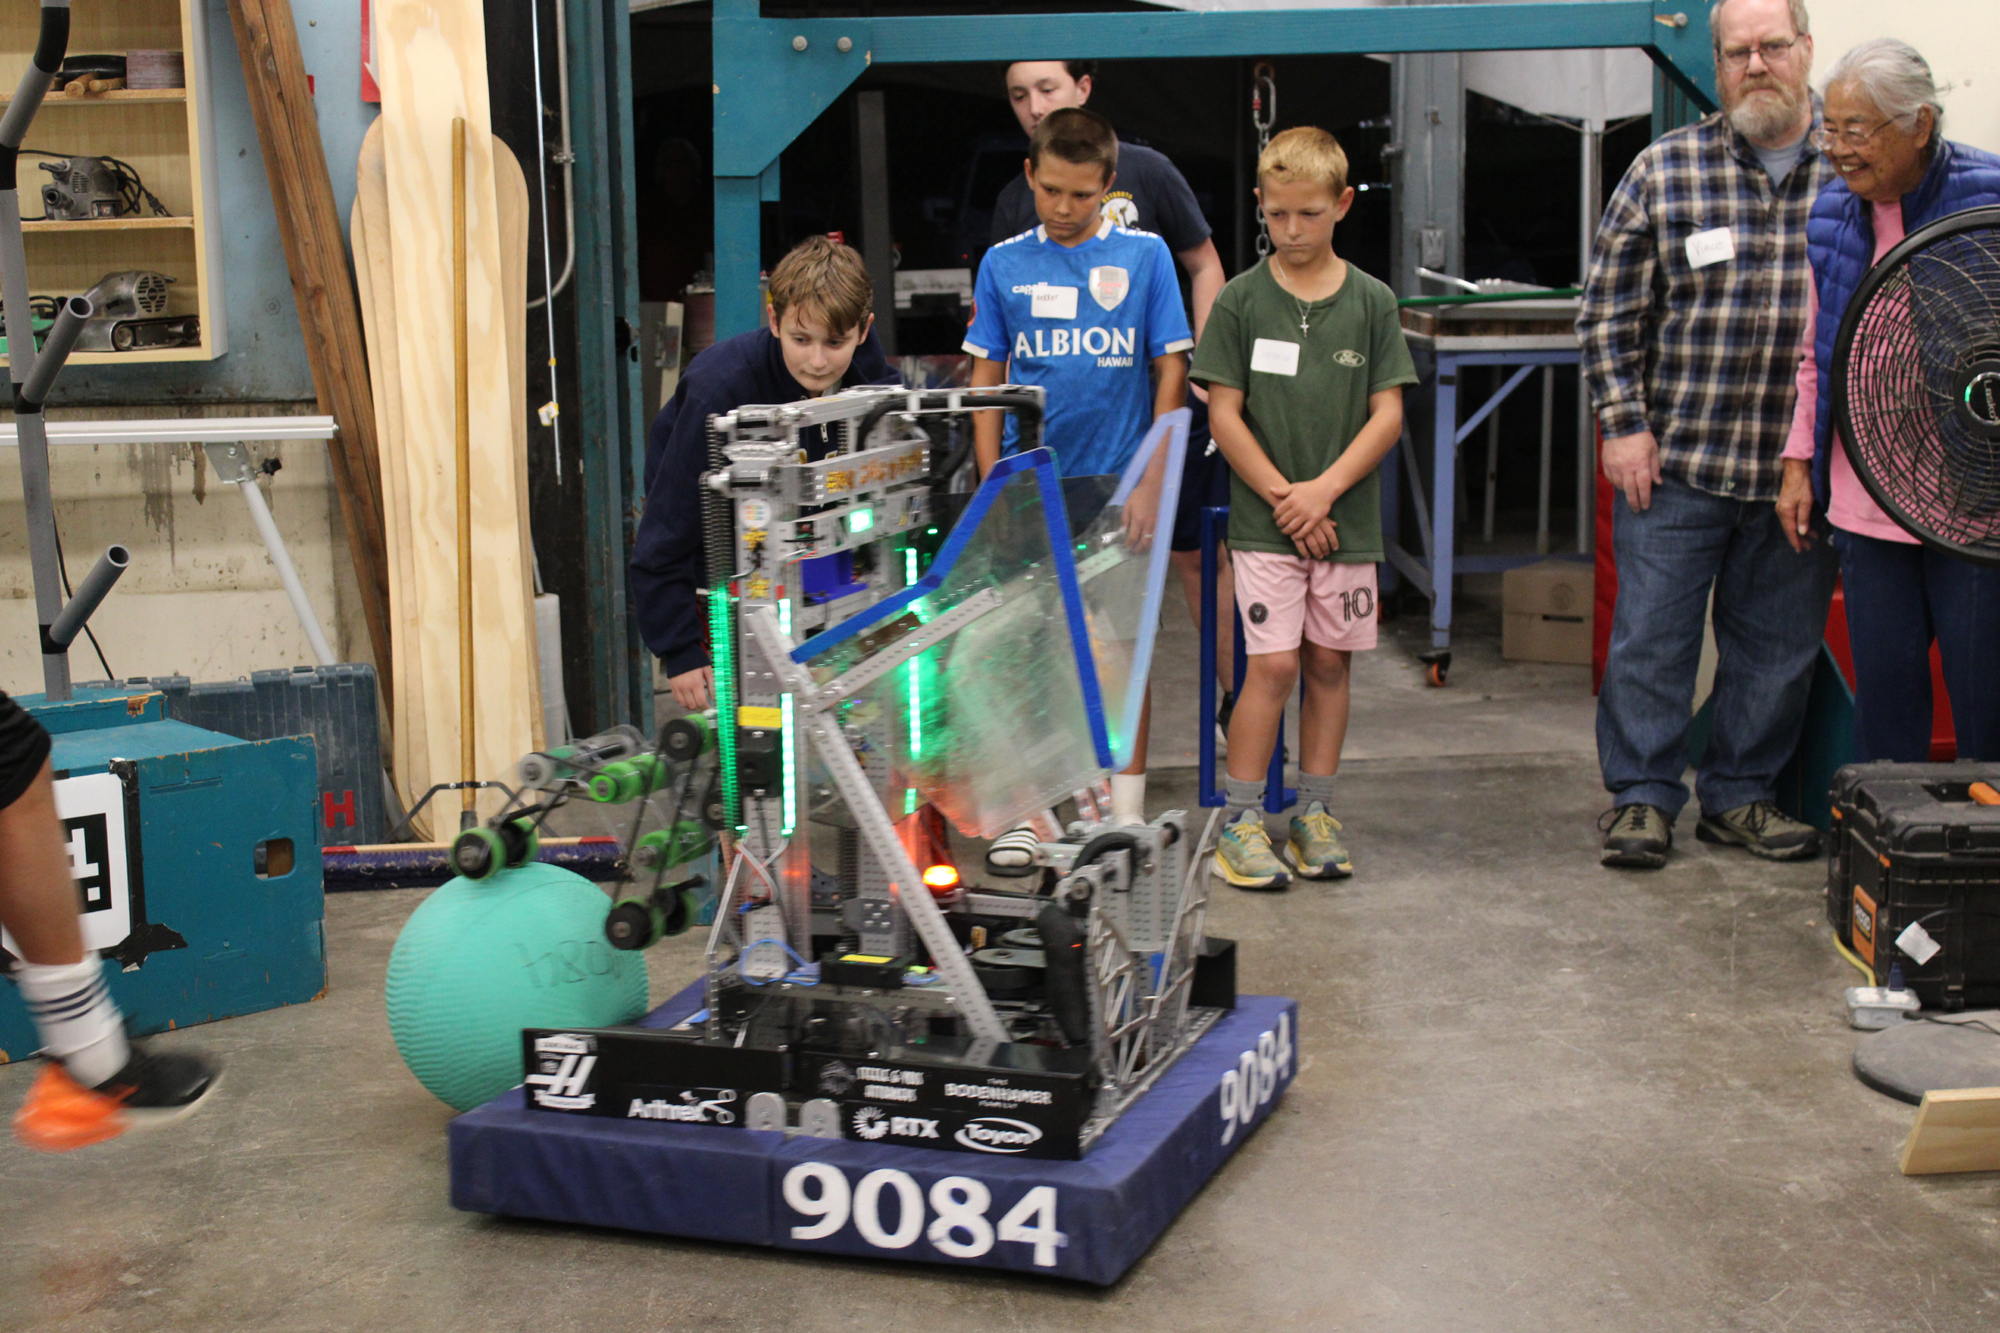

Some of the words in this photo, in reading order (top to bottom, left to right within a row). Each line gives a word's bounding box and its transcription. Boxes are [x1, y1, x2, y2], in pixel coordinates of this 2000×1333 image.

[1014, 326, 1136, 359] ALBION
[1097, 357, 1134, 367] HAWAII
[1983, 379, 1996, 420] Lasko
[1339, 586, 1374, 622] 10
[944, 1082, 1053, 1105] BODENHAMER
[1219, 1011, 1293, 1146] 9084
[890, 1116, 940, 1139] RTX
[964, 1123, 1034, 1145] Toyon
[782, 1161, 1068, 1267] 9084
